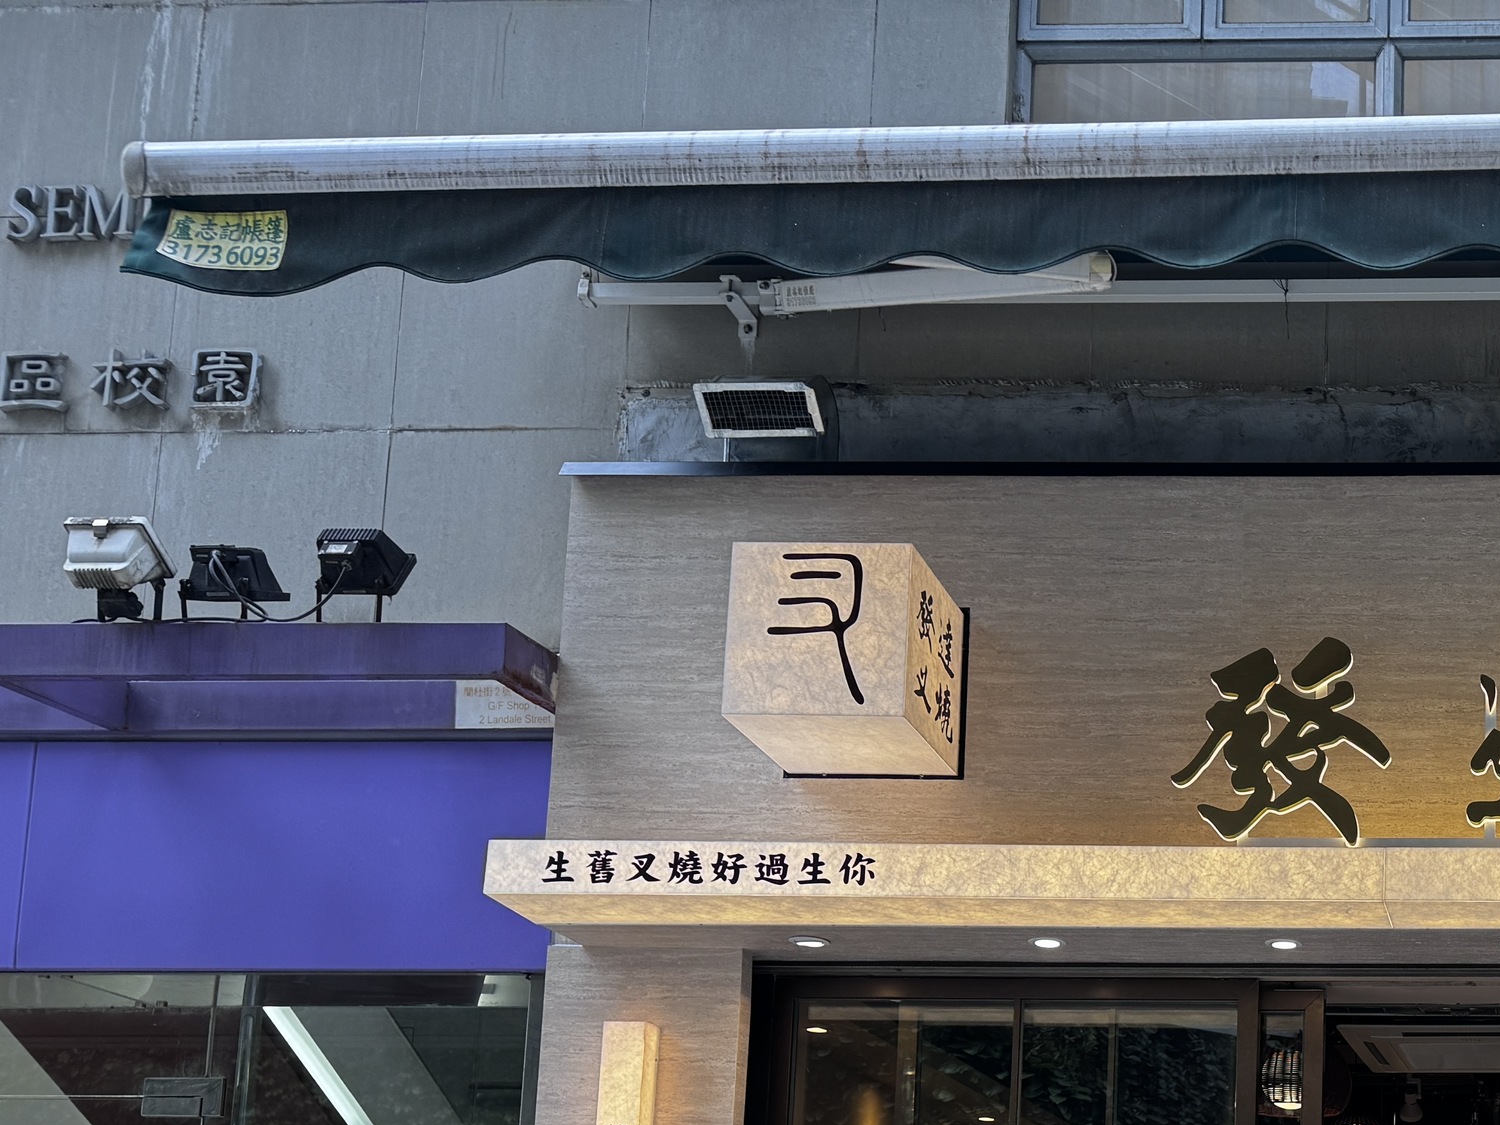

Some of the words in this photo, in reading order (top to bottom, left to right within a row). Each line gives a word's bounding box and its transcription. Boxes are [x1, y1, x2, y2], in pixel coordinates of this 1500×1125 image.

[169, 215, 285, 245] 盧志記帳篷
[0, 349, 263, 412] 區校園
[487, 714, 522, 724] Landale
[525, 714, 551, 724] Street
[507, 701, 530, 711] Shop
[541, 850, 876, 886] 生舊叉燒好過生你
